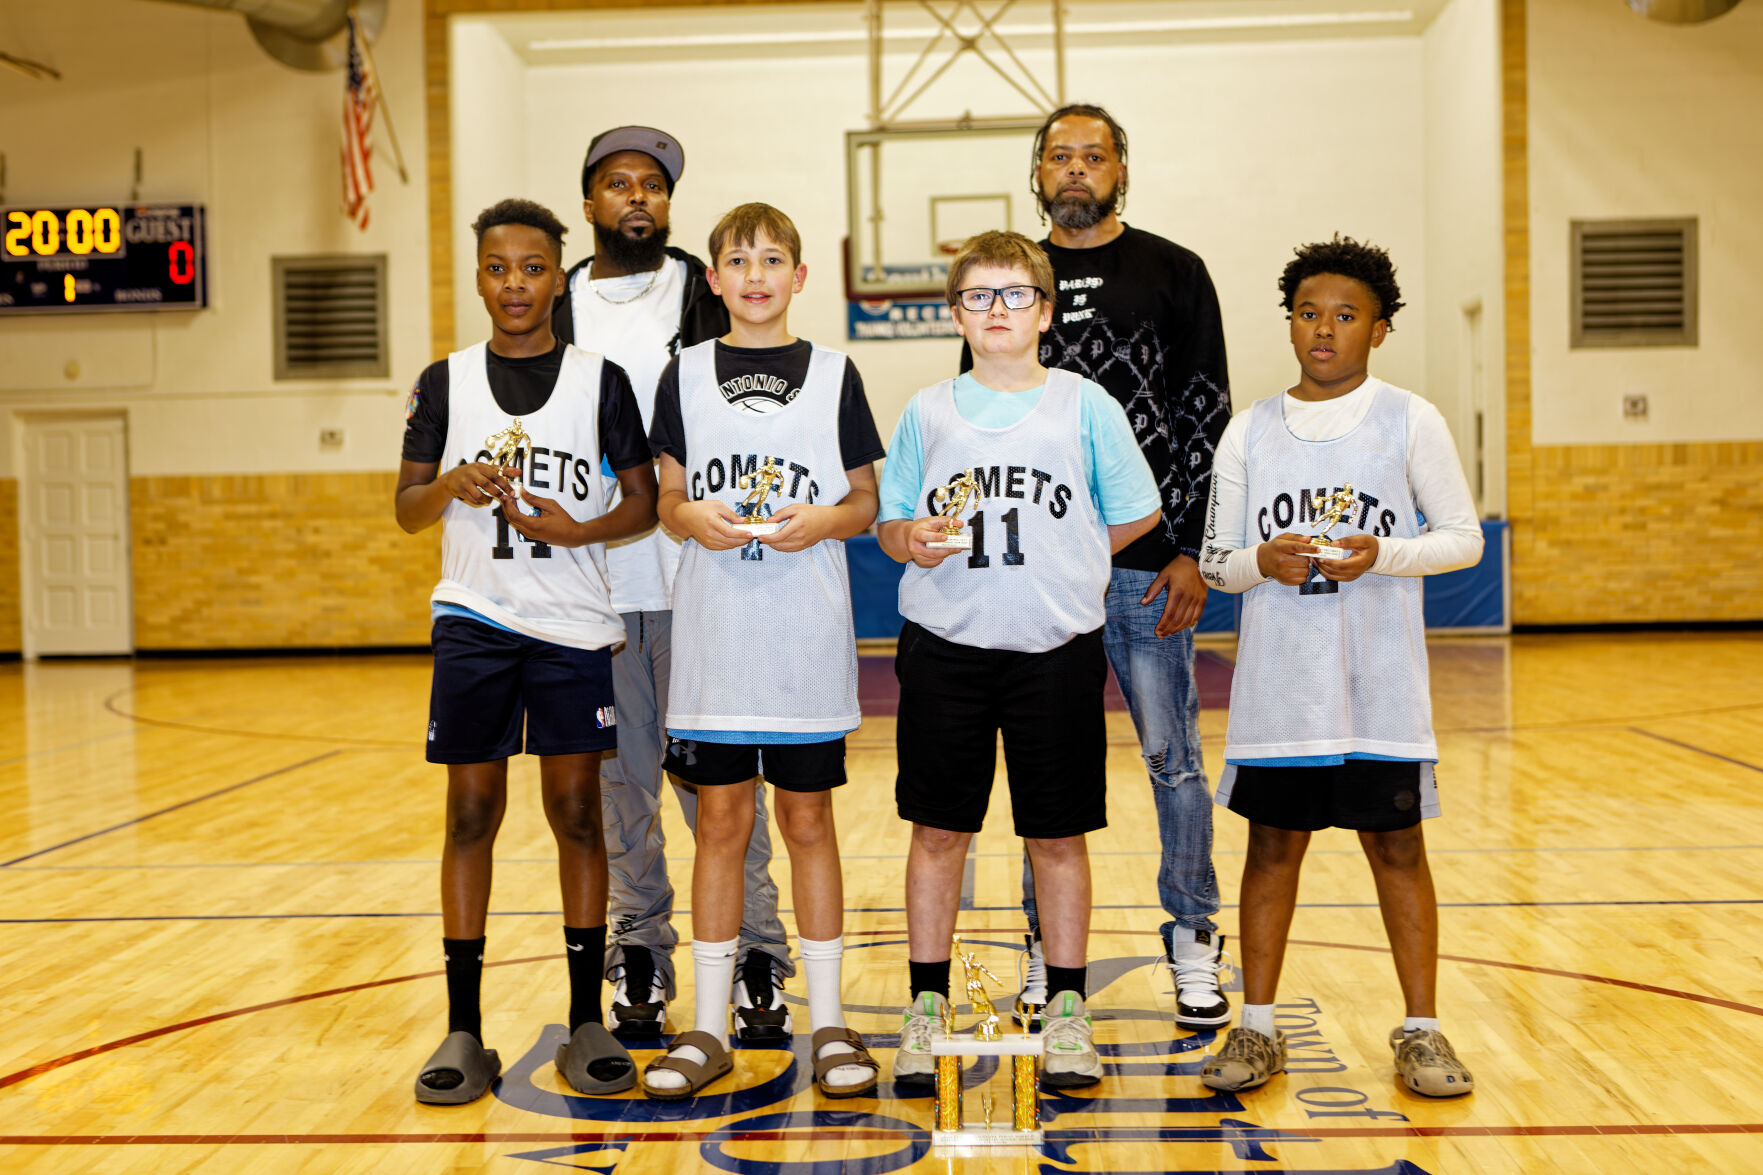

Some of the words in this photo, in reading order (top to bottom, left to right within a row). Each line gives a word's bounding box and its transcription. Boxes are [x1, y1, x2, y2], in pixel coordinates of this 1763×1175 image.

[126, 217, 193, 243] GUEST
[168, 240, 195, 284] 0
[64, 273, 76, 302] 1
[457, 446, 590, 502] METS
[967, 507, 1025, 569] 11
[1295, 1086, 1411, 1123] of
